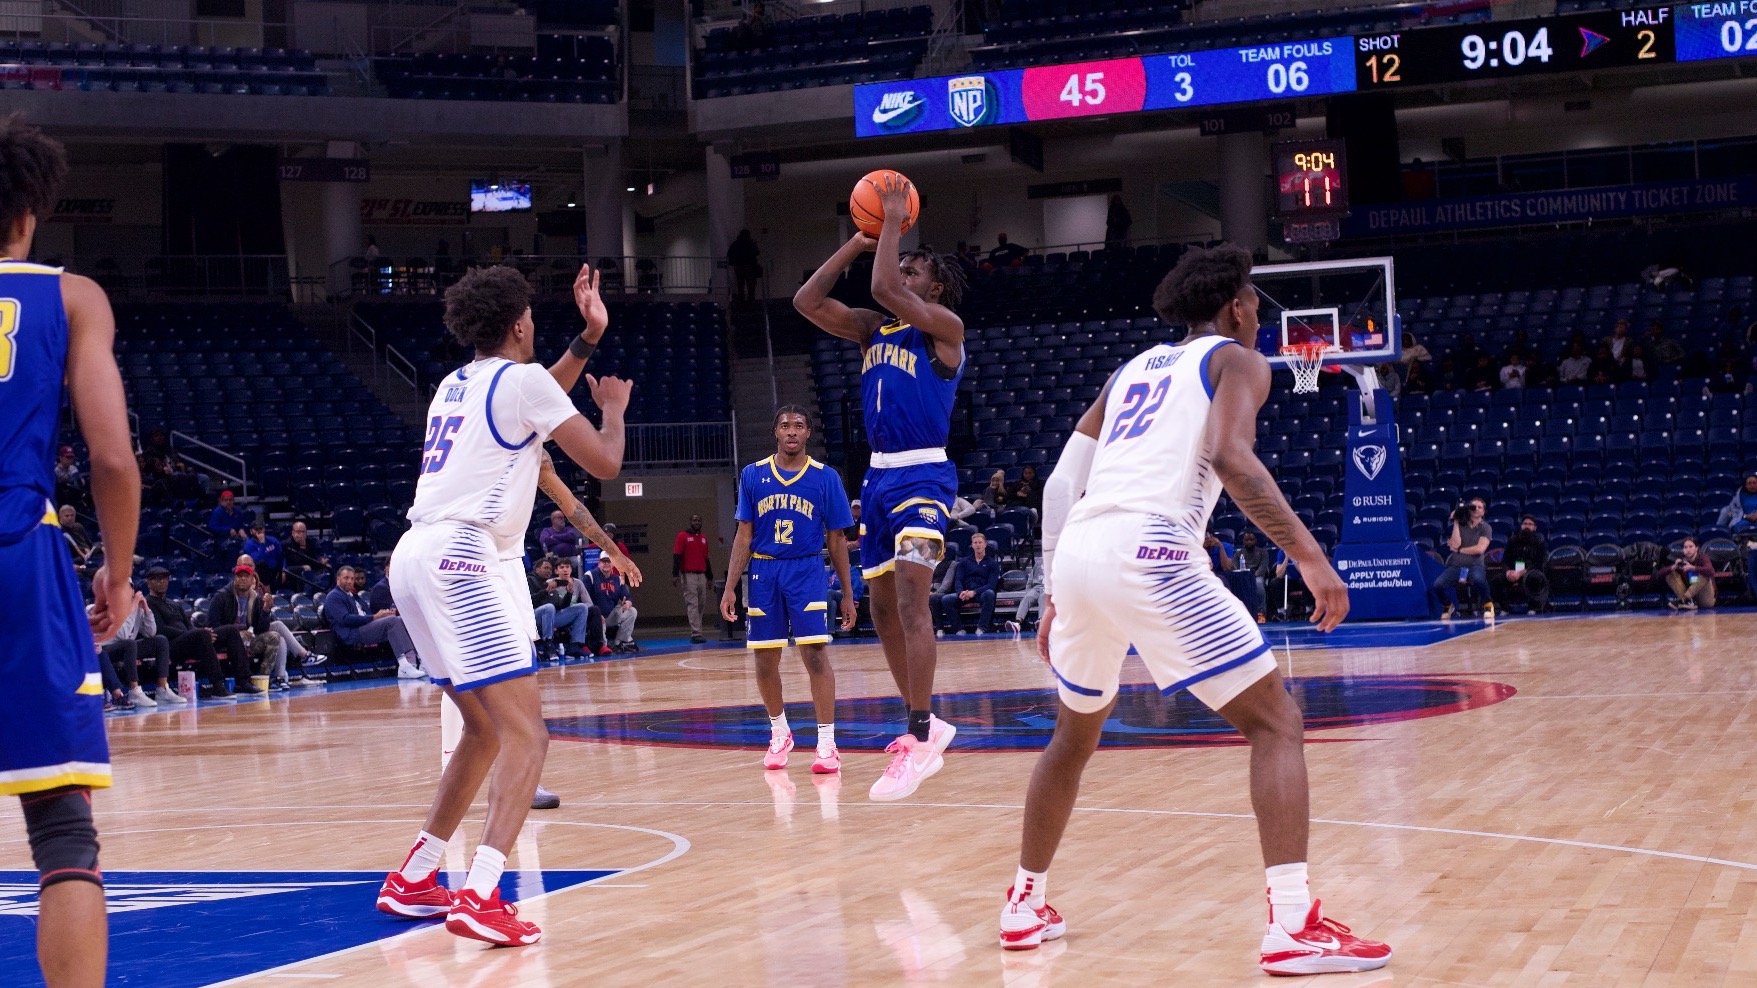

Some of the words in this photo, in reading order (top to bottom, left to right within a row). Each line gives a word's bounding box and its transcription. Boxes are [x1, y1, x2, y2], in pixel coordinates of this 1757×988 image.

[1621, 8, 1670, 27] HALF
[1691, 2, 1736, 18] TEAM
[1359, 34, 1400, 51] SHOT
[1461, 27, 1553, 69] 9:04
[1637, 30, 1657, 59] 2
[1721, 18, 1757, 52] 02
[1169, 55, 1196, 68] TOL
[1239, 46, 1280, 63] TEAM
[1283, 42, 1333, 60] FOULS
[1267, 61, 1309, 93] 06
[1365, 54, 1400, 83] 12
[1060, 72, 1106, 106] 45
[1174, 72, 1194, 101] 3
[880, 91, 915, 110] NIKE
[952, 91, 982, 122] NP
[1202, 119, 1225, 131] 101
[1266, 112, 1291, 126] 102
[279, 165, 302, 179] 127
[344, 166, 367, 180] 128
[1294, 152, 1335, 172] 9:04
[1304, 176, 1331, 207] 11
[1368, 207, 1430, 229] DEPAUL
[1435, 199, 1521, 225] ATHLETICS
[1526, 191, 1627, 217] COMMUNITY
[1632, 185, 1690, 209] TICKET
[1695, 182, 1738, 204] ZONE
[883, 343, 917, 379] PARK
[1104, 374, 1172, 448] 22
[420, 416, 465, 475] 25
[627, 484, 640, 495] EXIT
[1363, 495, 1392, 507] RUSH
[758, 494, 789, 518] NORTH
[789, 494, 814, 521] PARK
[774, 519, 794, 544] 12
[1350, 571, 1374, 580] APPLY
[1376, 569, 1401, 579] TODAY
